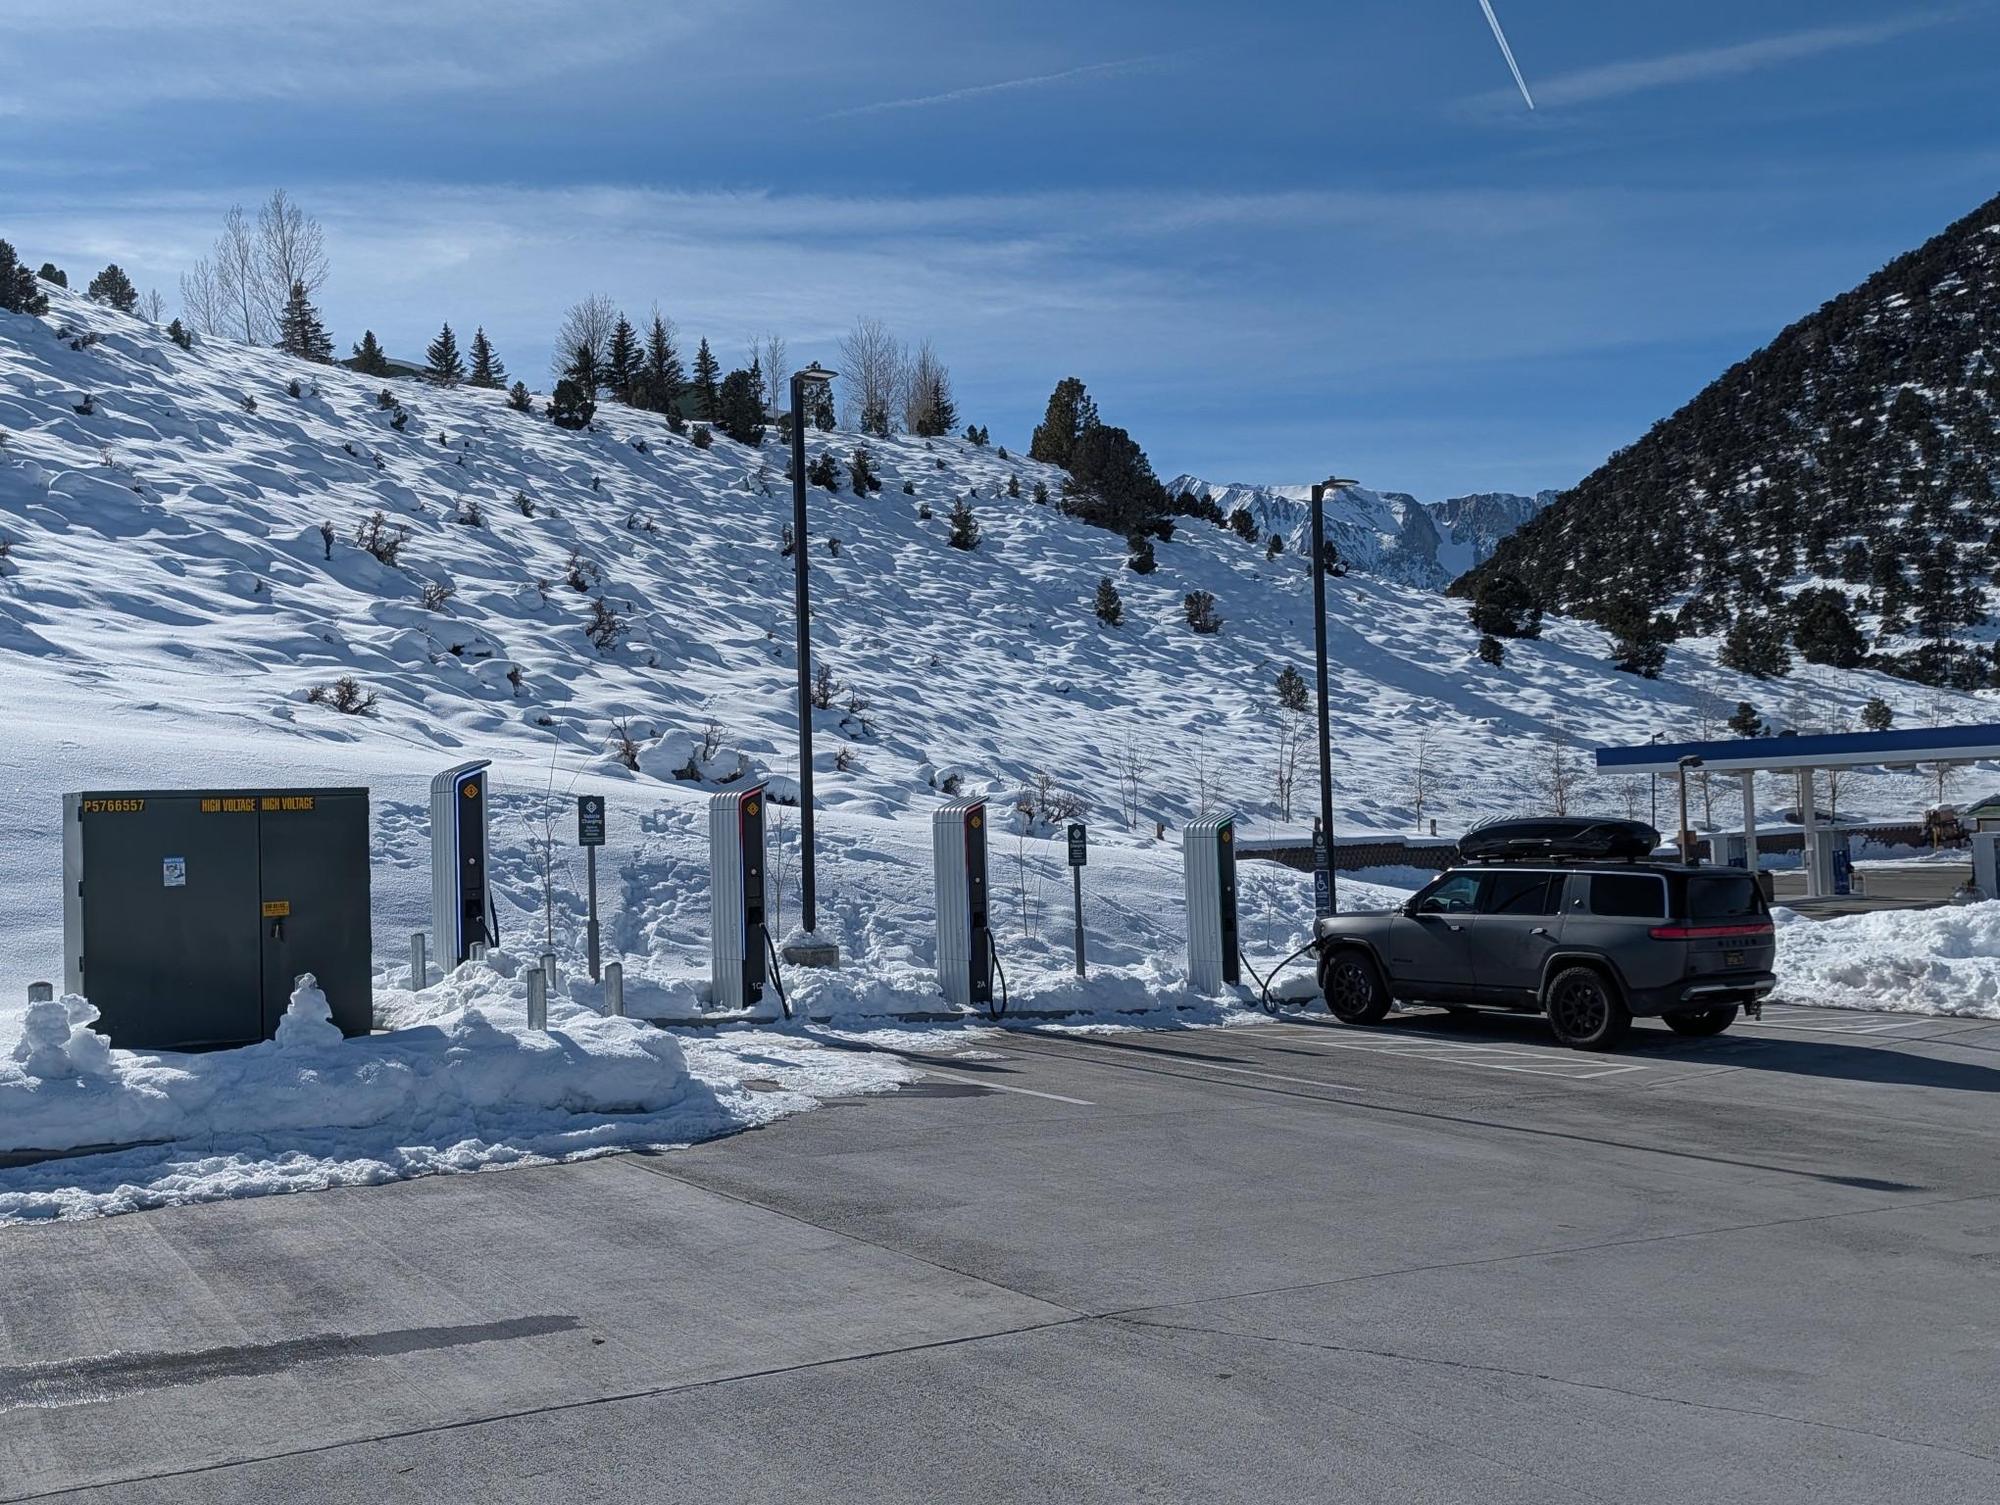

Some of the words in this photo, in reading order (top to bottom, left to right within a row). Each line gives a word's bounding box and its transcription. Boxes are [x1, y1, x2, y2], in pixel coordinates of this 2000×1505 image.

[84, 799, 145, 813] P5766557
[202, 799, 220, 812] HIGH
[222, 799, 255, 812] VOLTAGE
[262, 797, 280, 810] HIGH
[281, 797, 314, 810] VOLTAGE
